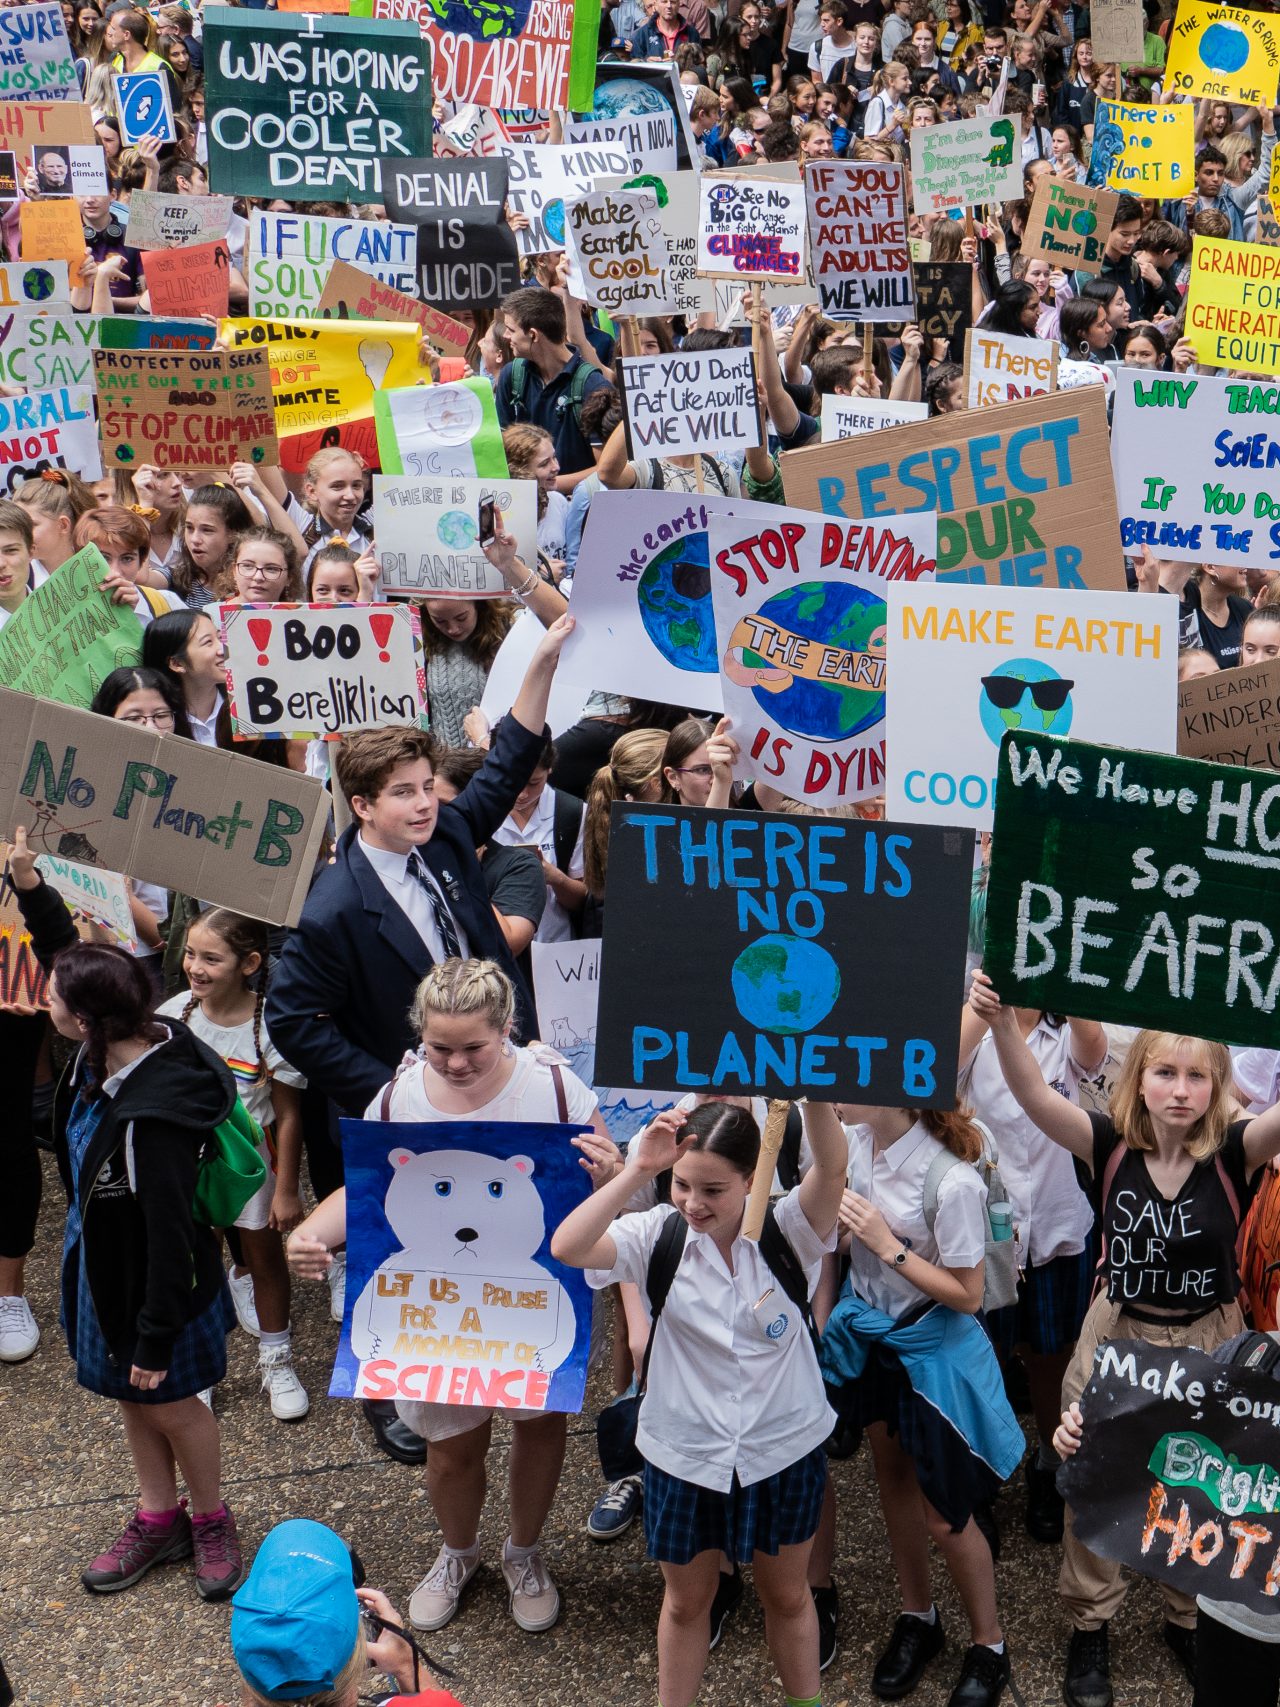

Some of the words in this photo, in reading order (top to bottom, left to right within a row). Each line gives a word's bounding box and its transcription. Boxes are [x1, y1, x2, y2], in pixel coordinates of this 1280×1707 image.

[299, 13, 323, 38] I
[220, 40, 306, 83] WAS
[312, 47, 425, 92] HOPING
[1174, 71, 1194, 89] SO
[1202, 82, 1231, 96] ARE
[1240, 88, 1261, 101] WE
[290, 90, 348, 115] FOR
[356, 92, 379, 115] A
[1108, 103, 1157, 124] There
[1162, 113, 1176, 124] is
[211, 108, 412, 155] COOLER
[72, 170, 104, 178] climate
[396, 172, 500, 207] DENIAL
[812, 170, 834, 192] IF
[844, 169, 901, 192] YOU
[571, 198, 636, 229] Make
[739, 188, 765, 204] See
[767, 190, 790, 209] No
[815, 194, 896, 219] CAN'T
[705, 223, 714, 233] in
[716, 222, 731, 233] the
[735, 222, 756, 235] fight
[763, 222, 799, 235] Against
[750, 206, 786, 226] Change
[437, 218, 465, 249] IS
[581, 224, 644, 254] Earth
[817, 224, 854, 245] ACT
[859, 221, 905, 245] LIKE
[819, 250, 909, 273] ADULTS
[596, 272, 668, 310] again!
[95, 352, 181, 371] PROTECT
[189, 352, 222, 370] OUR
[229, 352, 263, 369] SEAS
[622, 364, 653, 391] IF
[660, 359, 701, 388] YOU
[710, 357, 755, 382] Don't
[633, 391, 664, 415] Act
[1134, 379, 1198, 409] WHY
[105, 411, 180, 441] STOP
[633, 416, 680, 447] WE
[686, 412, 746, 442] WILL
[284, 619, 361, 662] BOO
[902, 606, 1015, 645] MAKE
[1034, 614, 1162, 660] EARTH
[1008, 741, 1082, 794] We
[1097, 758, 1199, 814] Have
[622, 814, 847, 893] THERE
[864, 832, 912, 898] IS
[737, 890, 825, 938] NO
[1013, 879, 1119, 987] BE
[633, 1025, 888, 1087] PLANET
[902, 1038, 937, 1098] B
[1112, 1190, 1202, 1238] SAVE
[1110, 1235, 1168, 1267] OUR
[376, 1273, 415, 1299] LET
[429, 1277, 460, 1303] US
[482, 1282, 548, 1310] PAUSE
[1108, 1267, 1217, 1298] FUTURE
[361, 1359, 551, 1408] SCIENCE
[1097, 1347, 1207, 1407] Make
